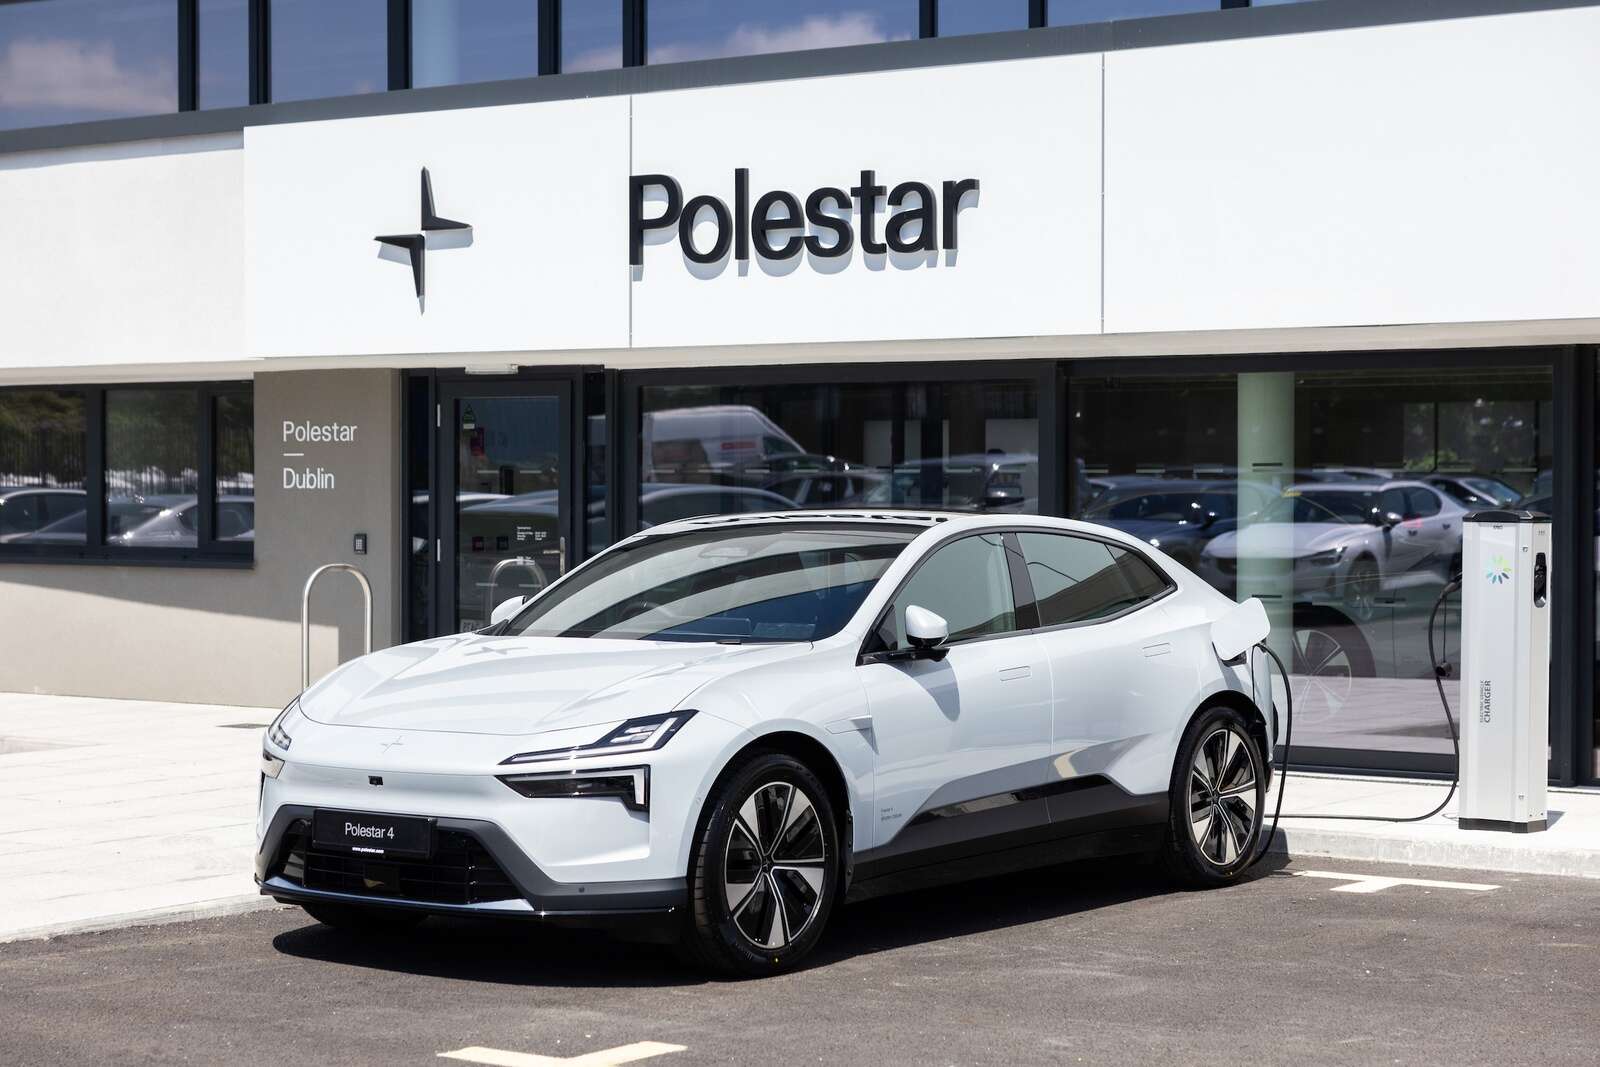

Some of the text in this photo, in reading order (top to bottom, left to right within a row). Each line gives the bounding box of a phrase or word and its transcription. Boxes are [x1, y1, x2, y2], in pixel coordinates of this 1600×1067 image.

[629, 168, 980, 266] Polestar
[283, 421, 358, 442] Polestar
[283, 467, 335, 489] Dublin
[345, 822, 394, 839] Polestar 4
